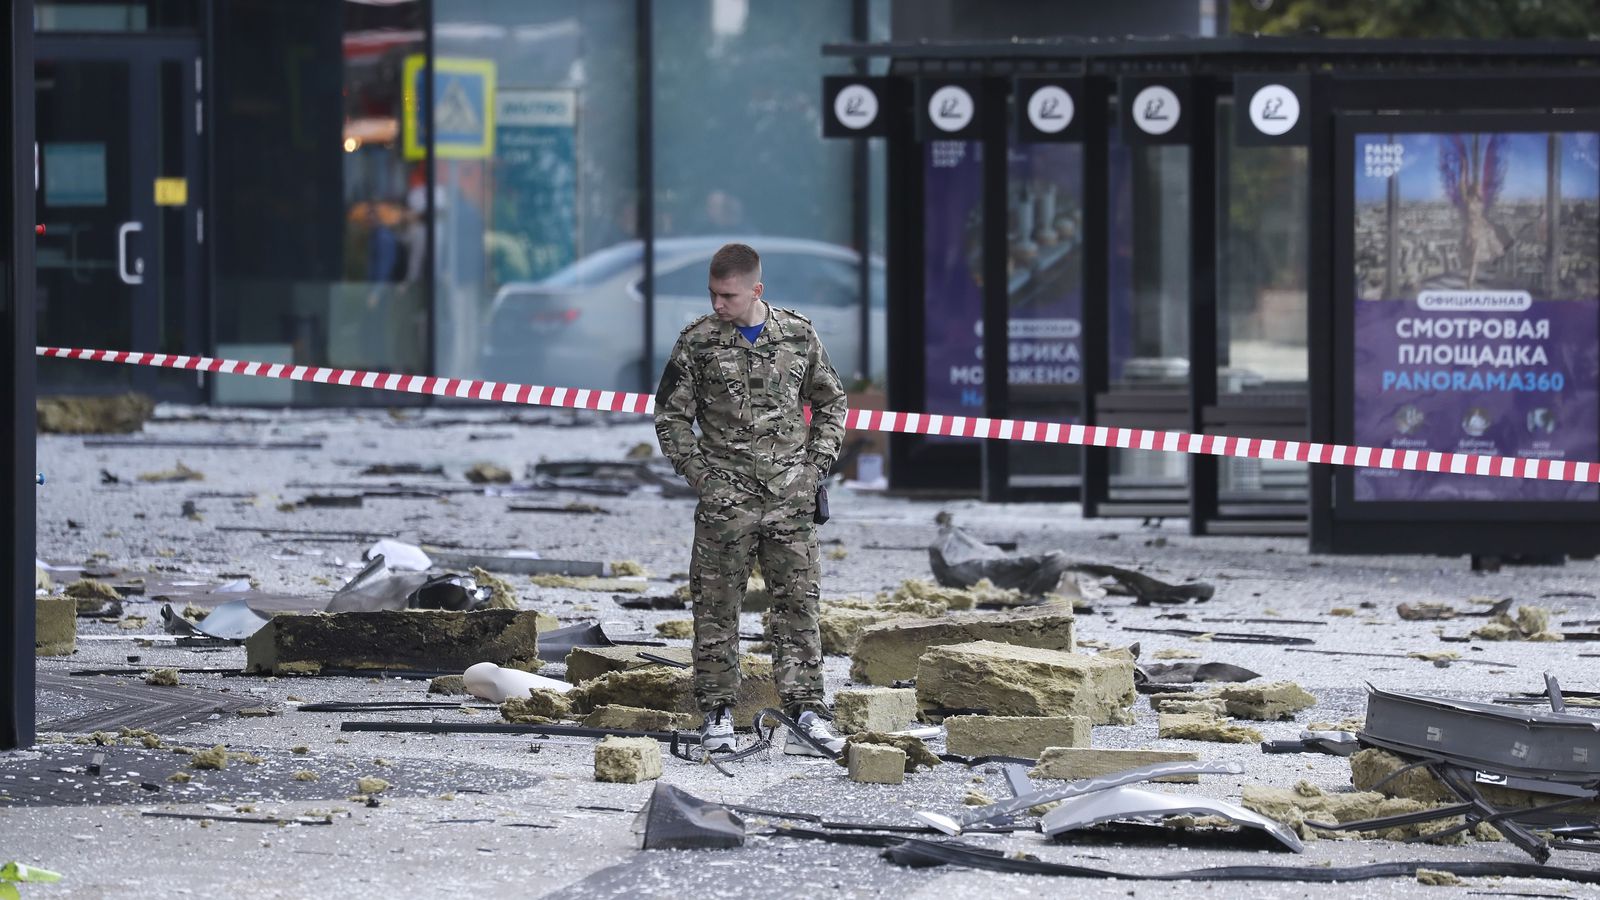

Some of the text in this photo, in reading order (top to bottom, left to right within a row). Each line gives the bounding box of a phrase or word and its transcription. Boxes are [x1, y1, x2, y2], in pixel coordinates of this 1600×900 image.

[1364, 143, 1404, 154] PANO
[1425, 295, 1524, 307] ОФИЦИАЛЬНАЯ
[1396, 318, 1550, 340] СМОТРОВАЯ
[1398, 344, 1549, 368] ПЛОЩАДКА
[1382, 370, 1566, 392] PANORAMA360
